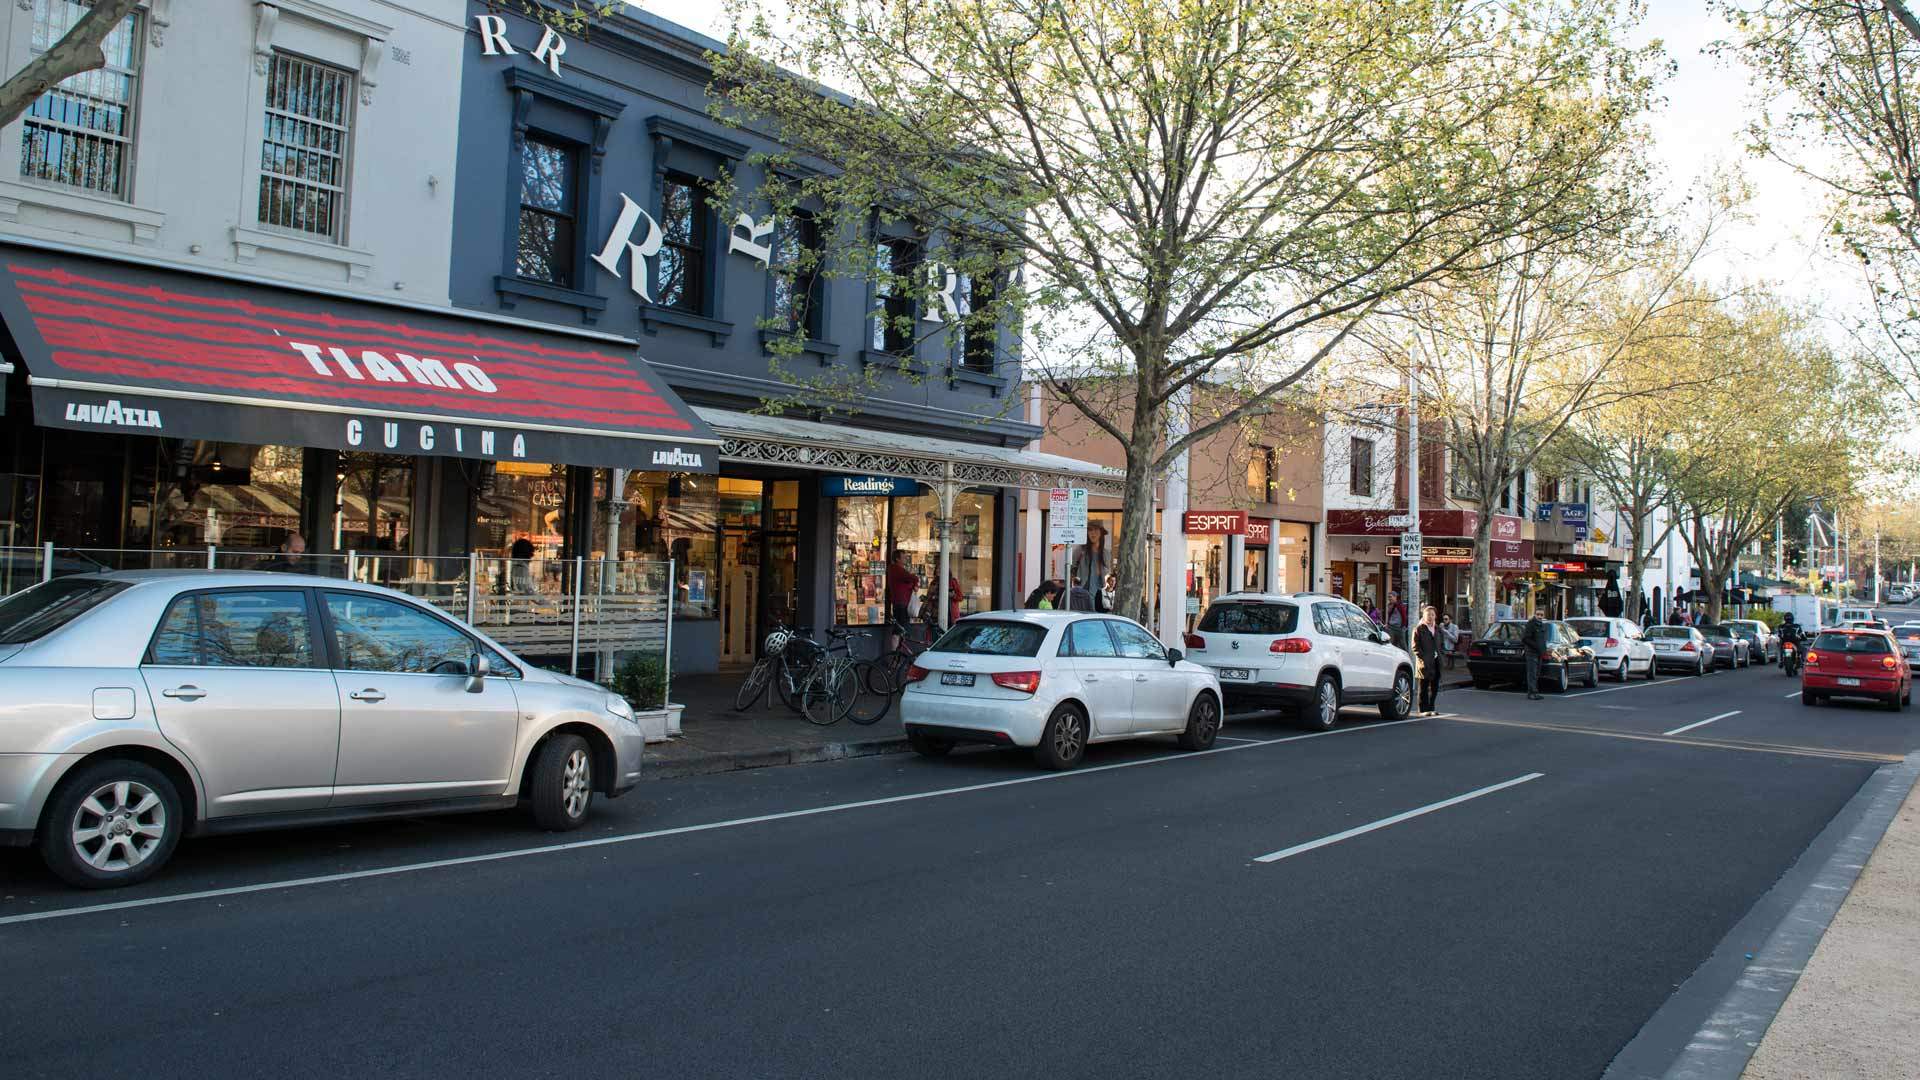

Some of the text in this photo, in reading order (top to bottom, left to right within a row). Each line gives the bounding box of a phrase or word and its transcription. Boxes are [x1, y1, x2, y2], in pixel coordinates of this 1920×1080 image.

[474, 15, 519, 56] R
[530, 23, 567, 78] R
[591, 192, 664, 304] R
[729, 212, 775, 269] R
[922, 258, 960, 323] R
[64, 399, 162, 429] LAVAZZA
[346, 419, 526, 458] CUCINA
[652, 447, 703, 467] LAVAZZA
[843, 477, 895, 495] Readings
[532, 493, 560, 507] CASE
[1188, 515, 1240, 531] ESPRIT
[1564, 510, 1584, 519] AGE
[1247, 523, 1269, 542] SPRIT
[1404, 534, 1419, 542] ONE
